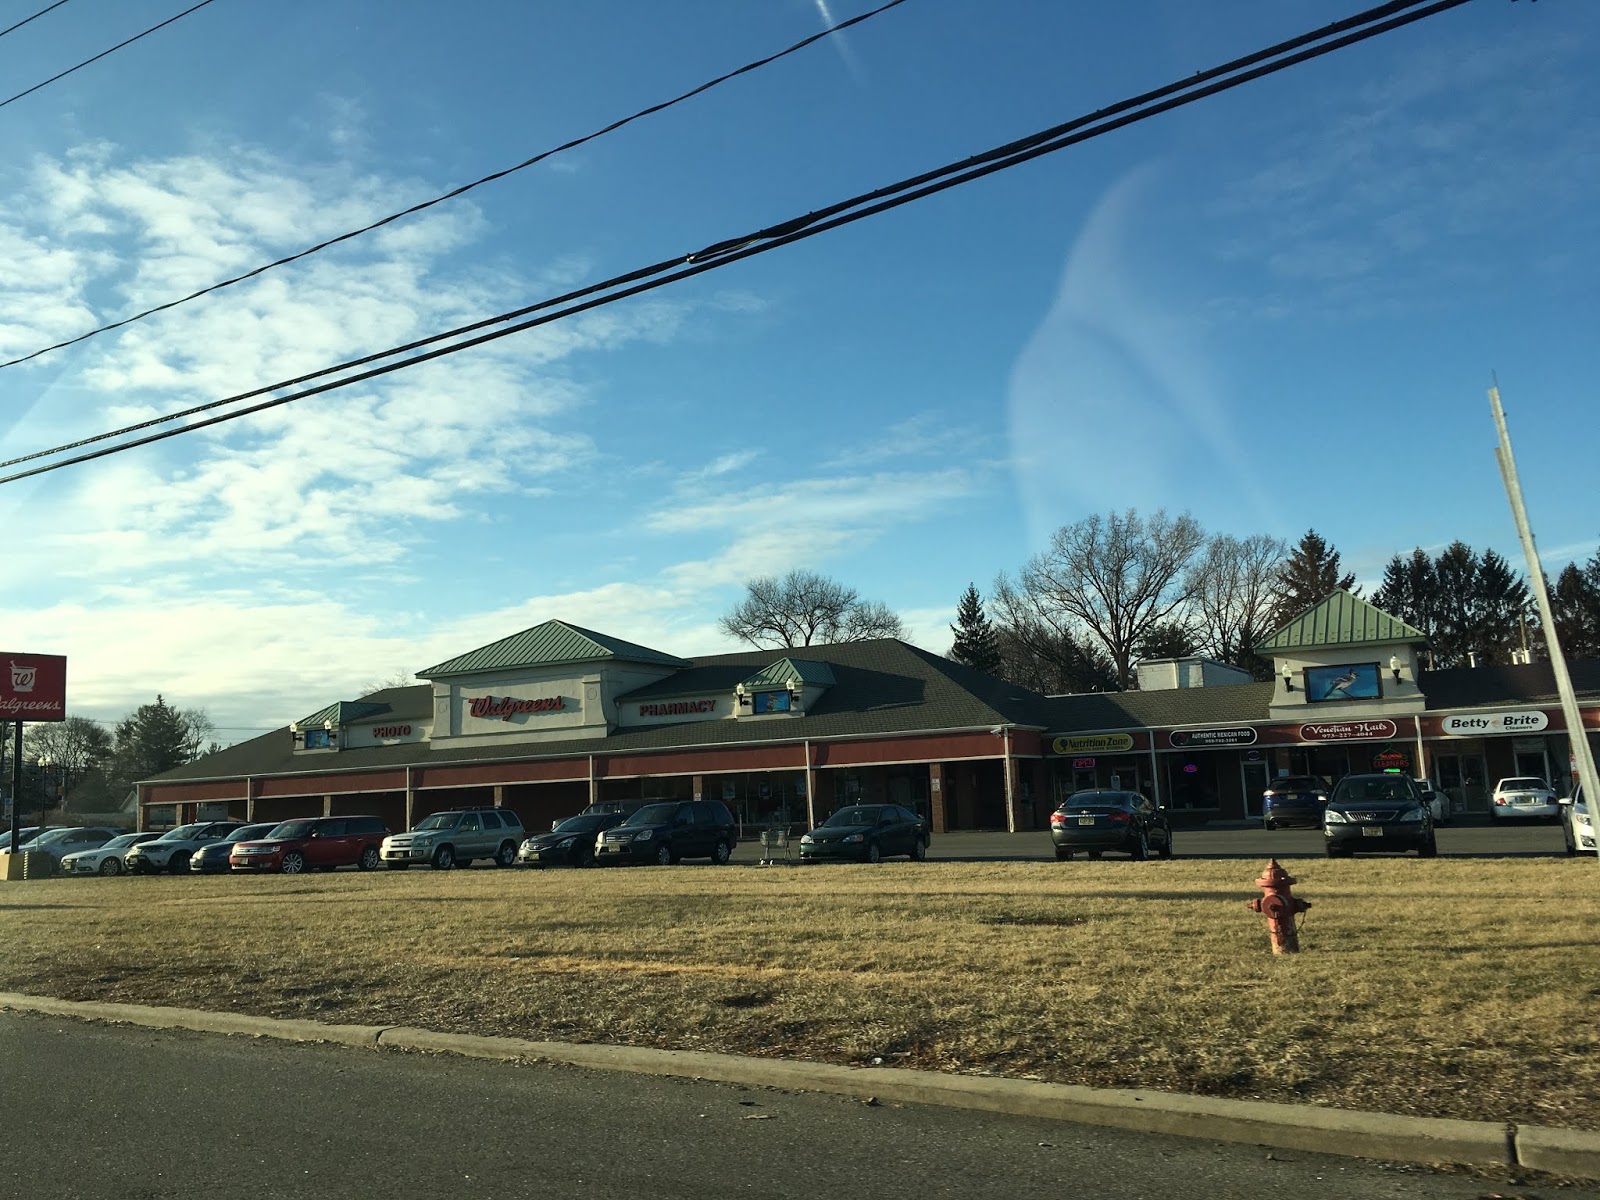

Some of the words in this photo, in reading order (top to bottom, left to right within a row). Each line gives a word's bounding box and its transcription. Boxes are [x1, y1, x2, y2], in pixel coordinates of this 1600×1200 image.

[0, 695, 61, 714] algreens
[468, 695, 566, 721] Walgreens
[639, 699, 716, 716] PHARMACY
[1306, 725, 1352, 734] Venetian
[1354, 722, 1388, 732] Nails
[1451, 718, 1490, 729] Betty
[1503, 716, 1539, 726] Brite
[373, 725, 412, 738] PHOTO
[1069, 739, 1106, 749] Nutrition
[1107, 737, 1129, 746] Zone
